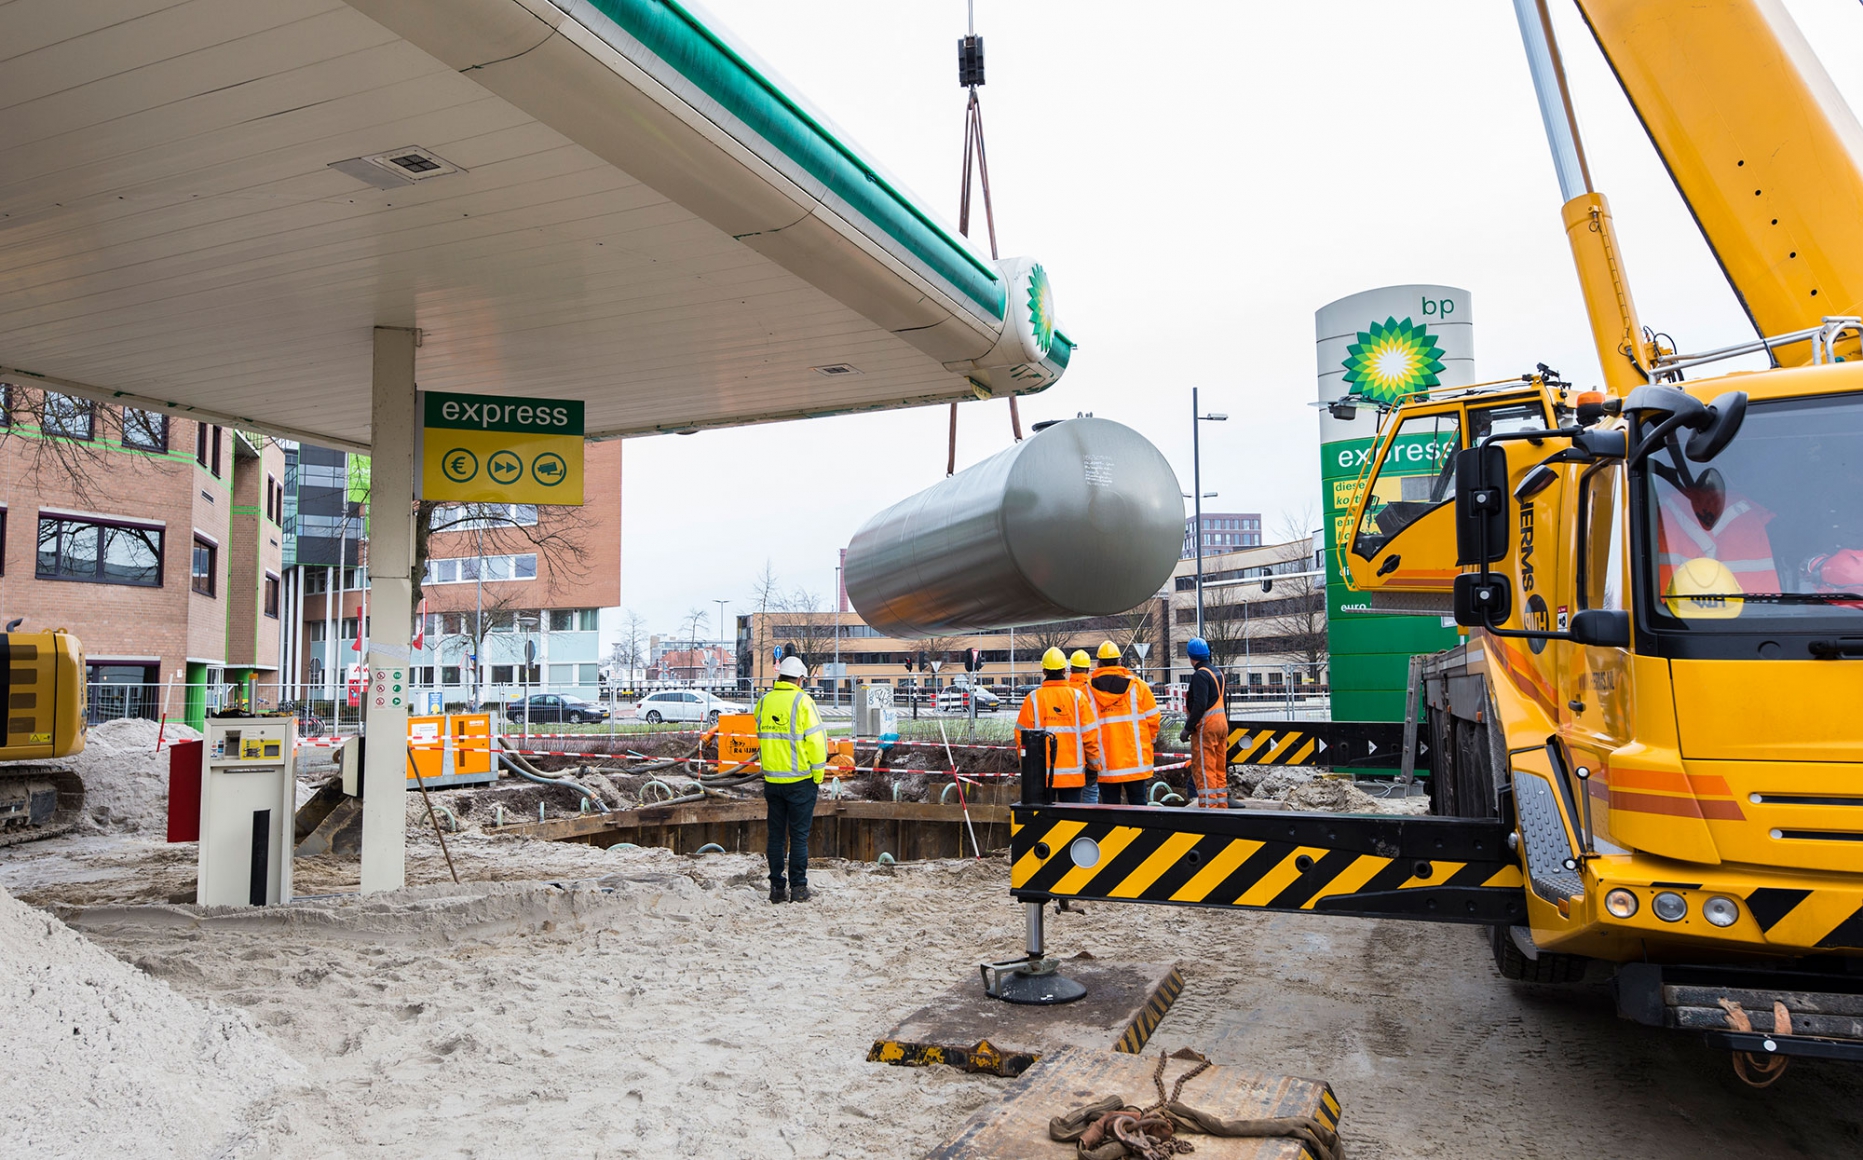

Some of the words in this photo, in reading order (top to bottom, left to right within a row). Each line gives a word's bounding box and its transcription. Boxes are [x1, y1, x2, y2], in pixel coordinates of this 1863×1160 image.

[1422, 296, 1455, 319] bp
[442, 400, 568, 428] express
[1336, 479, 1368, 492] diese
[1341, 603, 1367, 612] euro
